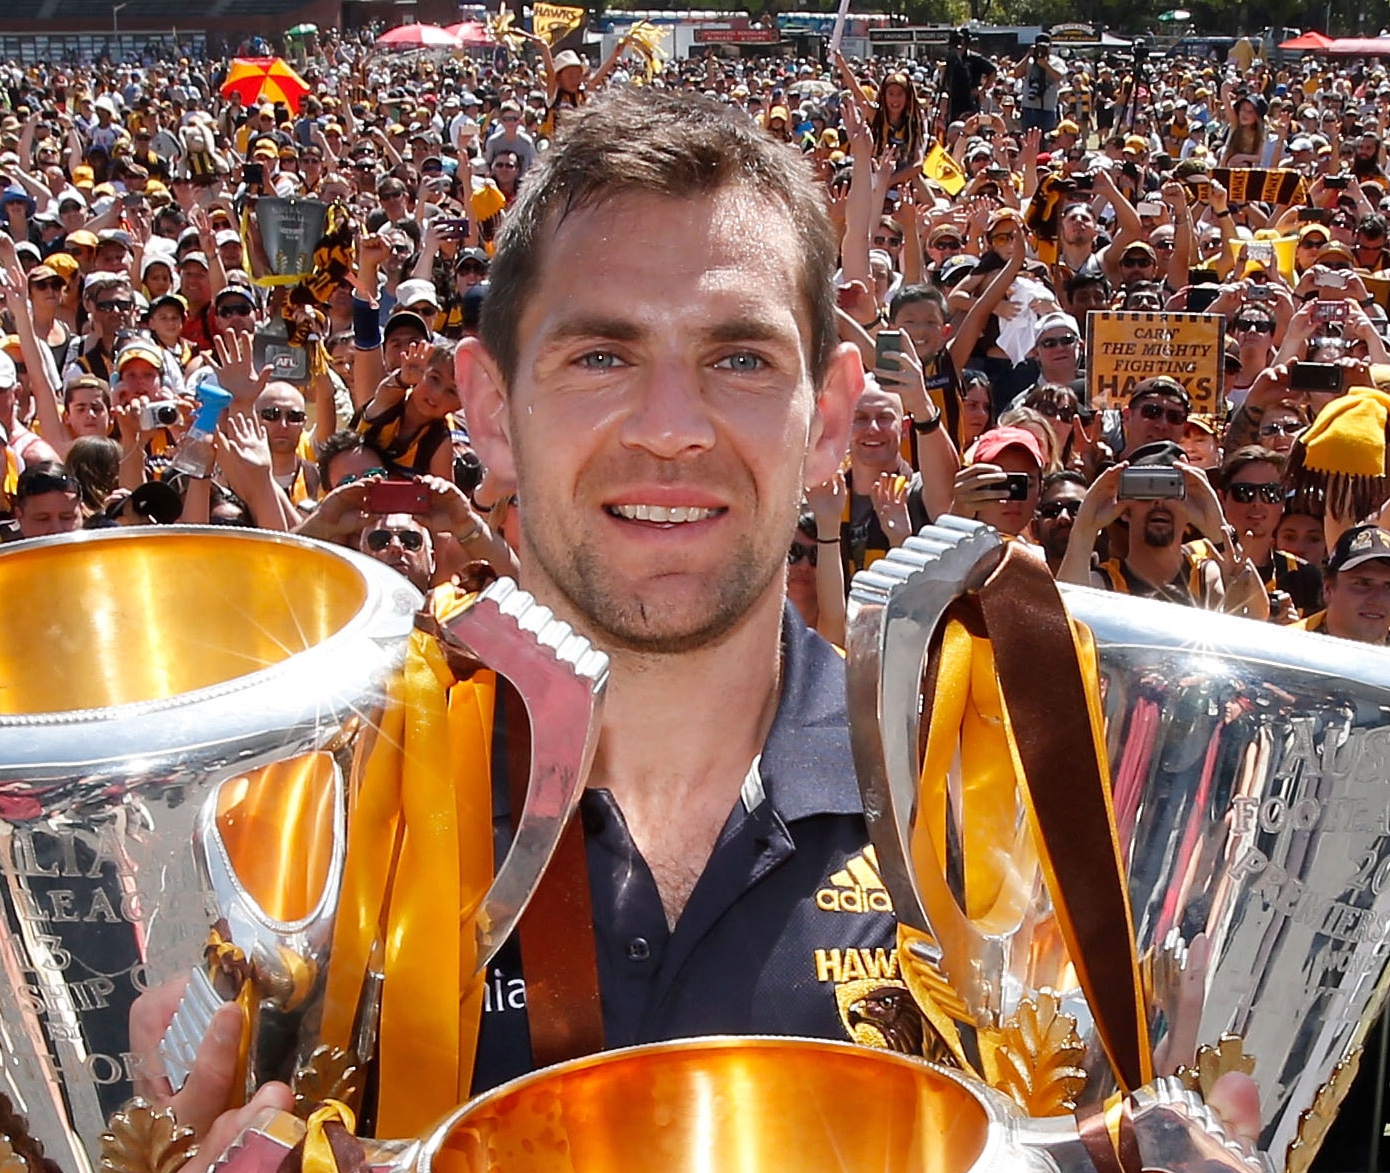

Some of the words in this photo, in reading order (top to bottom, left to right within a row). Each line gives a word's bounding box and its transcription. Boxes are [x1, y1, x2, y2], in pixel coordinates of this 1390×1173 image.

[535, 5, 577, 20] HAWKS
[1102, 342, 1137, 355] THE
[1141, 344, 1212, 357] MIGHTY
[275, 358, 297, 367] AFL
[1113, 360, 1198, 374] FIGHTING
[1098, 375, 1213, 401] HAKS
[814, 948, 898, 982] HAW
